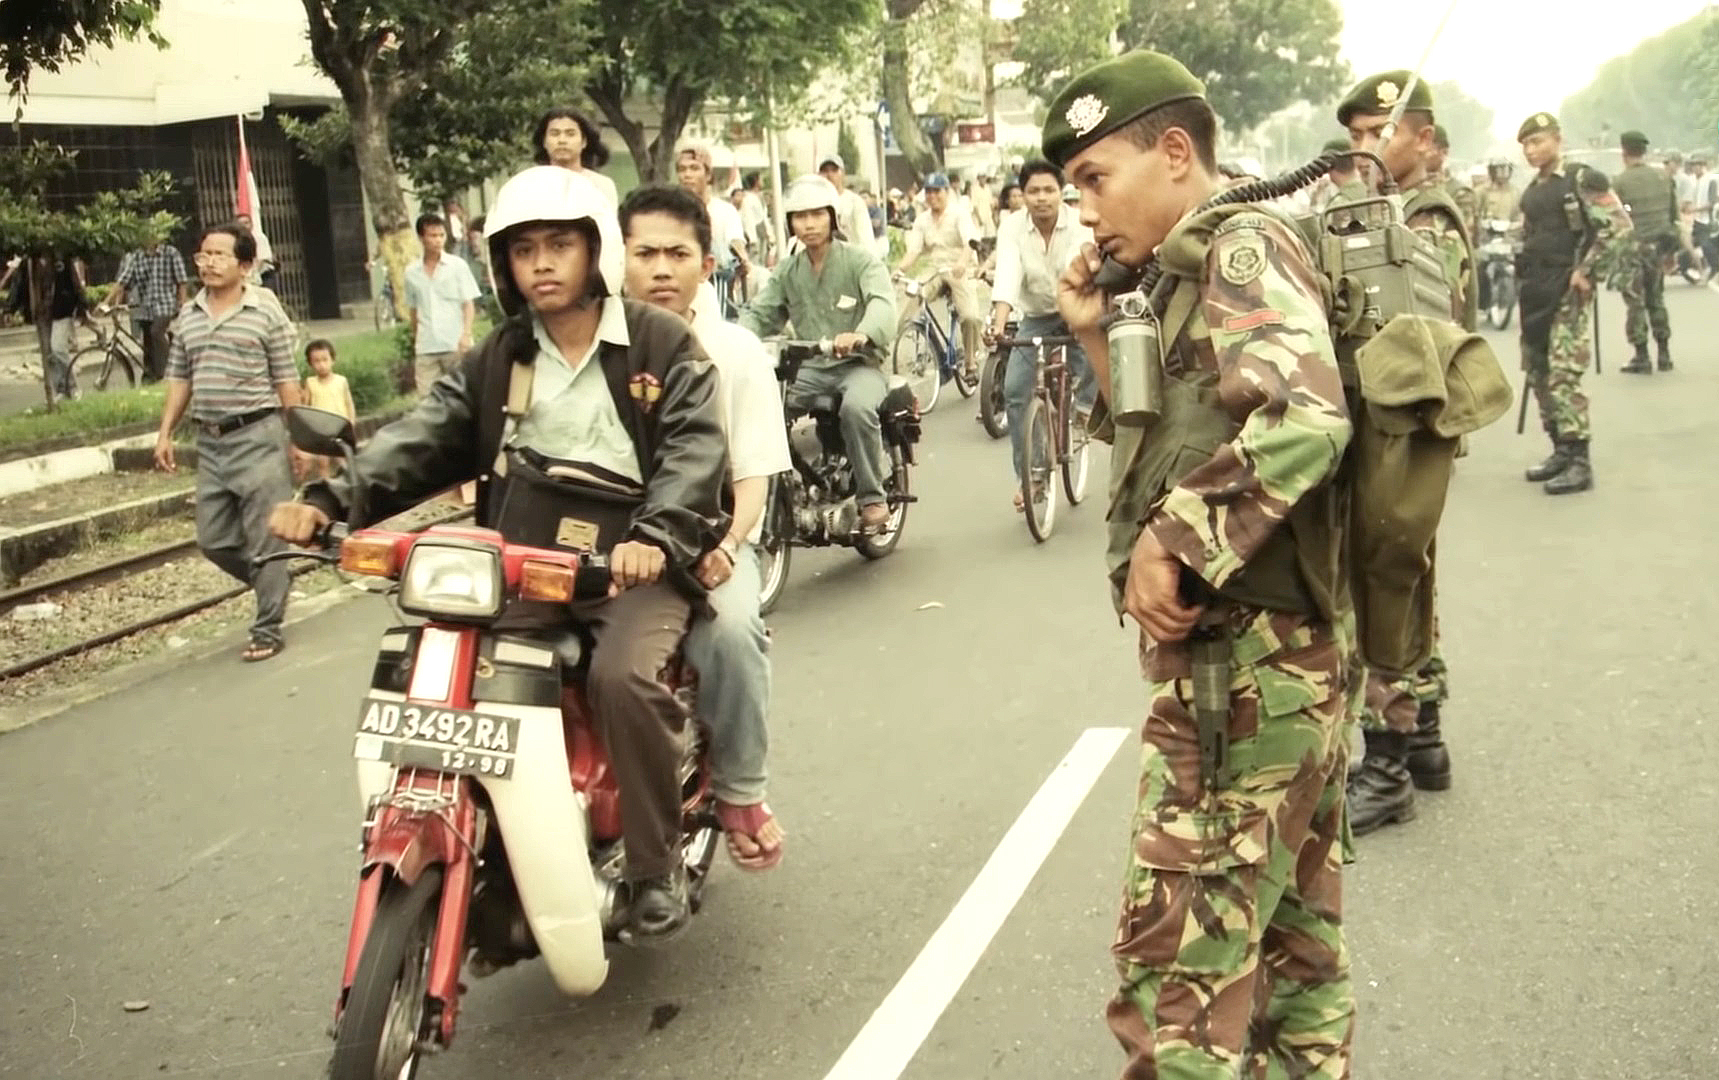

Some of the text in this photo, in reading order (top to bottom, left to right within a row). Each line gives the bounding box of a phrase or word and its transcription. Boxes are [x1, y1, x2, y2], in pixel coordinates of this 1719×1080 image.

[361, 702, 509, 751] AD 3492 RA
